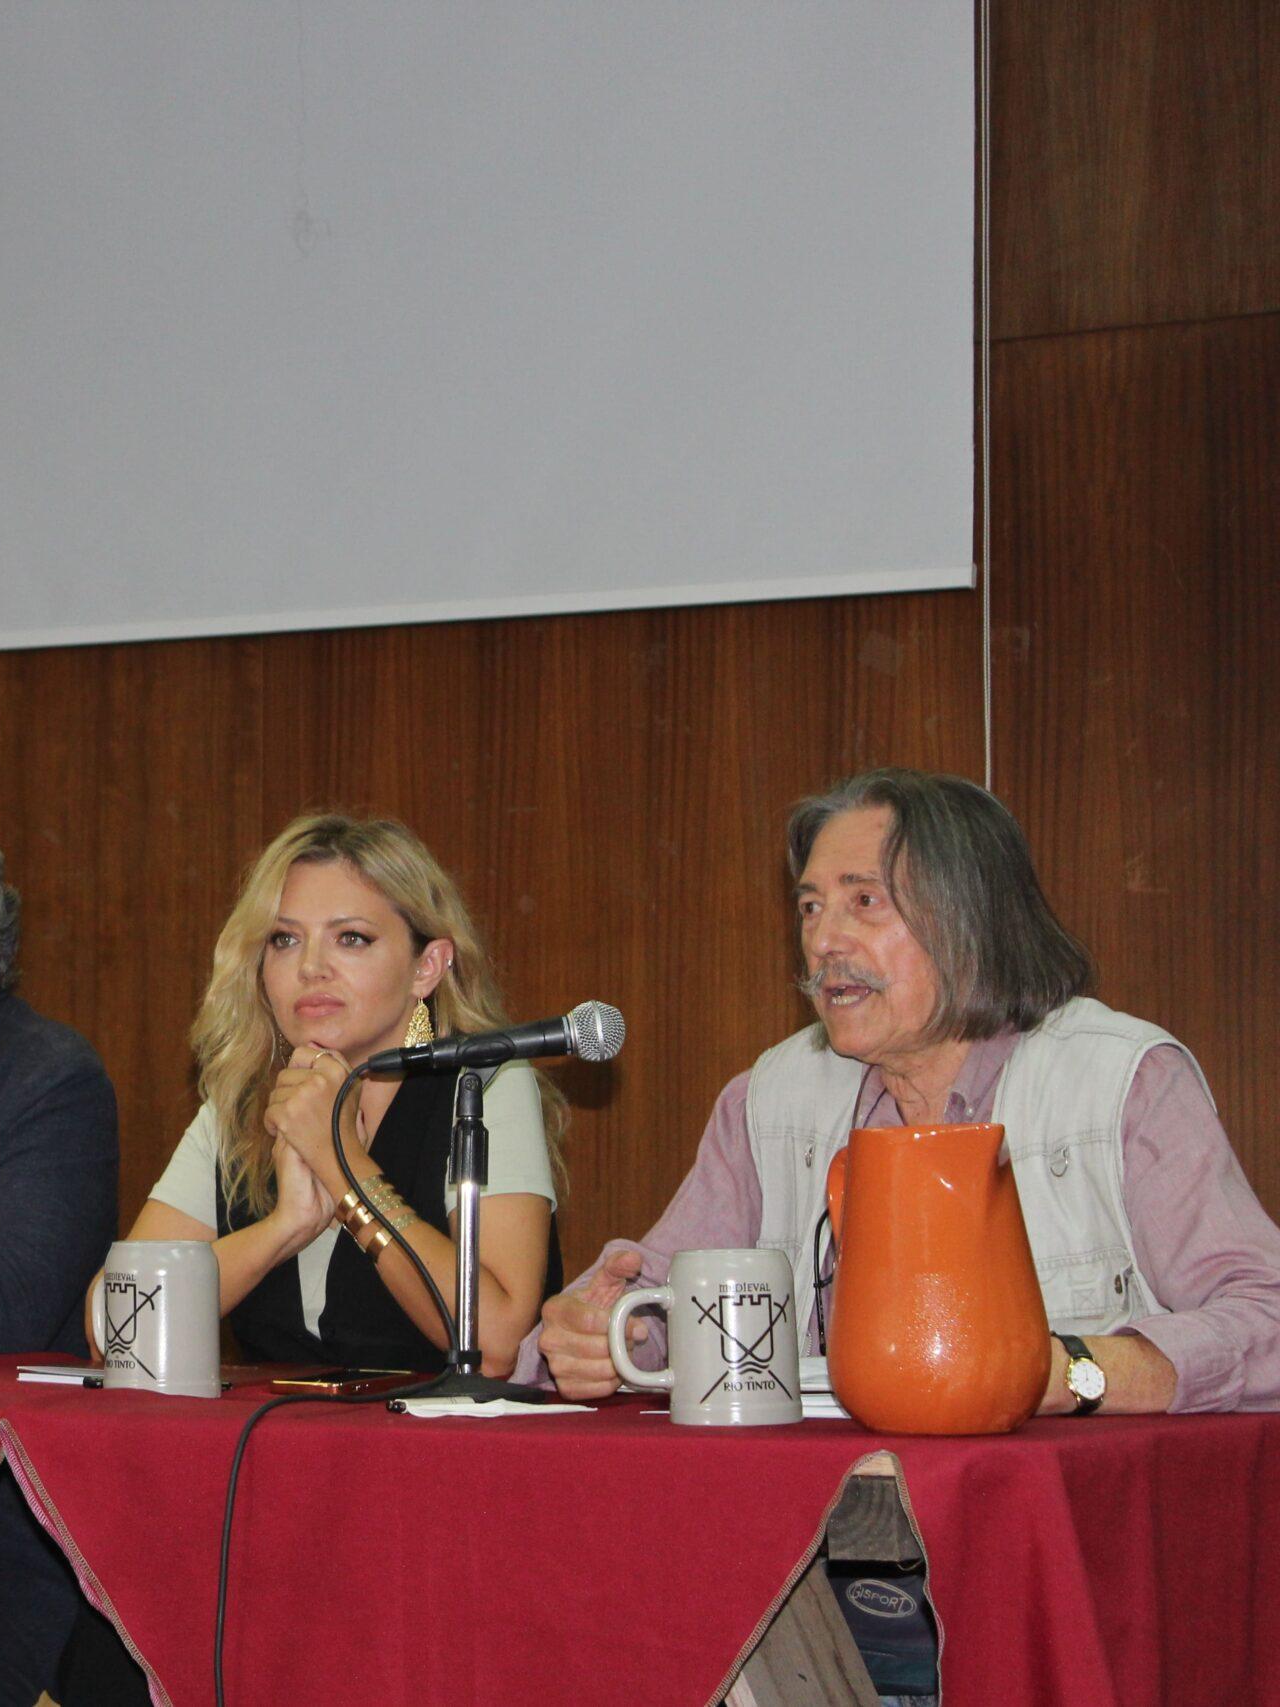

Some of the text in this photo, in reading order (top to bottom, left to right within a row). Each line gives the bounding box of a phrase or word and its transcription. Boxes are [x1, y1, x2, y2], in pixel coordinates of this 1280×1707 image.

[719, 1282, 771, 1293] MDIEVAL
[114, 1360, 135, 1369] TINTO
[745, 1379, 776, 1391] TINTO
